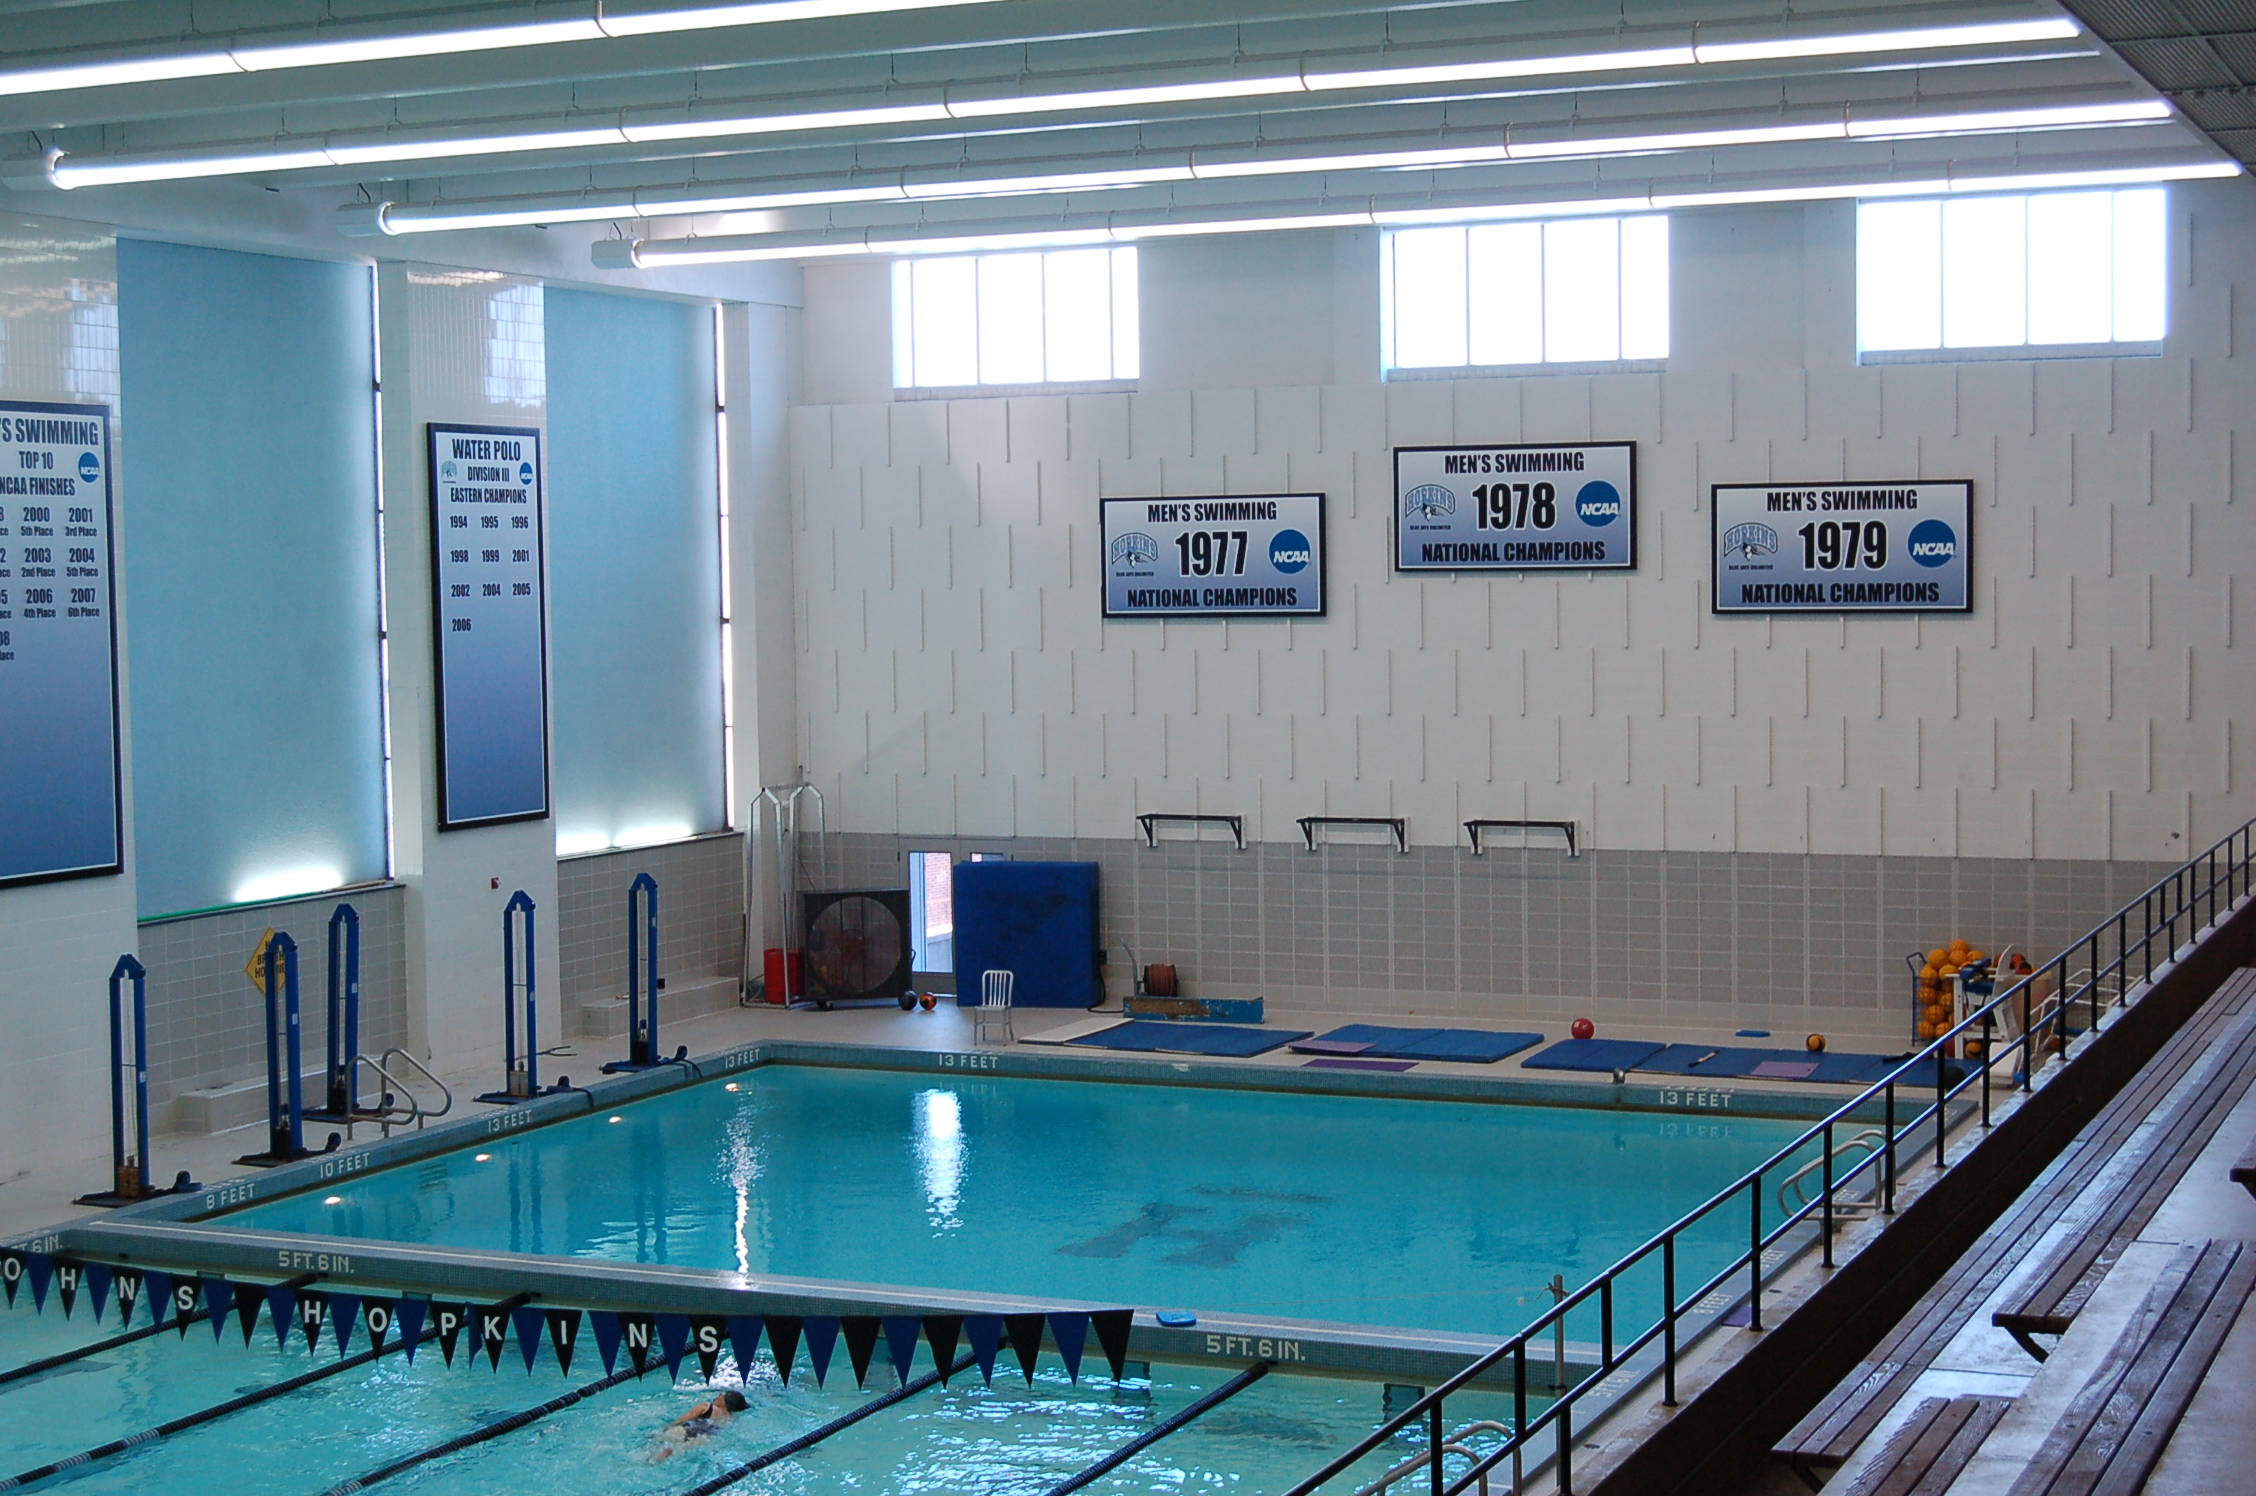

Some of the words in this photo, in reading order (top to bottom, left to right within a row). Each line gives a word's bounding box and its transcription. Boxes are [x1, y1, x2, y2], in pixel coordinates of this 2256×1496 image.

[15, 418, 99, 446] SWIMMING
[452, 439, 491, 460] WATER
[493, 440, 521, 461] POLO
[19, 451, 39, 469] TOP
[41, 452, 54, 470] 10
[1445, 454, 1491, 474] MEN'S
[1495, 452, 1584, 473] SWIMMING
[467, 466, 500, 482] DIVISION
[502, 467, 510, 482] III
[0, 477, 28, 495] NCAA
[30, 477, 76, 496] FINISHES
[451, 487, 482, 503] EASTERN
[484, 488, 527, 505] CHAMPIONS
[1406, 487, 1454, 515] HOPKINS
[1767, 491, 1817, 512] MEN'S
[1821, 489, 1918, 511] SWIMMING
[1148, 503, 1191, 523] MEN'S
[1194, 501, 1277, 522] SWIMMING
[1472, 482, 1556, 530] 1978
[1580, 503, 1619, 515] NCAA
[23, 507, 50, 522] 2000
[69, 507, 93, 522] 2001
[450, 516, 468, 529] 1994
[481, 516, 499, 529] 1995
[511, 516, 529, 529] 1996
[34, 526, 53, 536] Place
[65, 526, 77, 536] 3rd
[78, 526, 97, 536] Place
[1725, 525, 1776, 553] HOPKINS
[1175, 531, 1248, 576] 1977
[1422, 543, 1500, 562] NATIONAL
[1503, 541, 1605, 561] CHAMPIONS
[1799, 521, 1887, 570] 1979
[1913, 543, 1954, 556] NCAA
[24, 547, 52, 563] 2003
[69, 547, 95, 563] 2004
[450, 550, 469, 563] 1998
[482, 550, 500, 562] 1999
[512, 550, 530, 562] 2001
[1273, 550, 1311, 563] NCAA
[21, 567, 35, 577] 2nd
[36, 567, 56, 577] Place
[80, 566, 98, 577] Place
[26, 588, 53, 604] 2006
[71, 588, 96, 603] 2007
[451, 584, 470, 597] 2002
[482, 584, 501, 596] 2004
[513, 583, 531, 596] 2005
[1127, 589, 1199, 607] NATIONAL
[1203, 587, 1297, 606] CHAMPIONS
[1742, 583, 1826, 604] NATIONAL
[1830, 582, 1940, 603] CHAMPIONS
[37, 608, 56, 618] Place
[81, 607, 100, 617] Place
[452, 618, 471, 632] 2006
[725, 1055, 735, 1069] 13
[737, 1048, 760, 1066] FEET
[939, 1053, 954, 1067] 13
[960, 1055, 998, 1069] FEET
[1660, 1091, 1679, 1105] 13
[1686, 1092, 1732, 1108] FEET
[488, 1117, 500, 1134] 13
[504, 1110, 532, 1128] FEET
[320, 1162, 334, 1179] 10
[338, 1152, 370, 1174] FEET
[206, 1194, 215, 1210] 8
[221, 1183, 255, 1206] FEET
[279, 1250, 290, 1267] 5
[293, 1252, 315, 1270] FT.
[318, 1254, 330, 1271] 6
[333, 1255, 355, 1274] IN.
[0, 1257, 194, 1310] OHNS
[304, 1300, 719, 1354] HOPKINS
[1206, 1334, 1221, 1354] 5
[1226, 1336, 1253, 1357] FT.
[1258, 1339, 1273, 1358] 6
[1278, 1340, 1306, 1361] IN.
